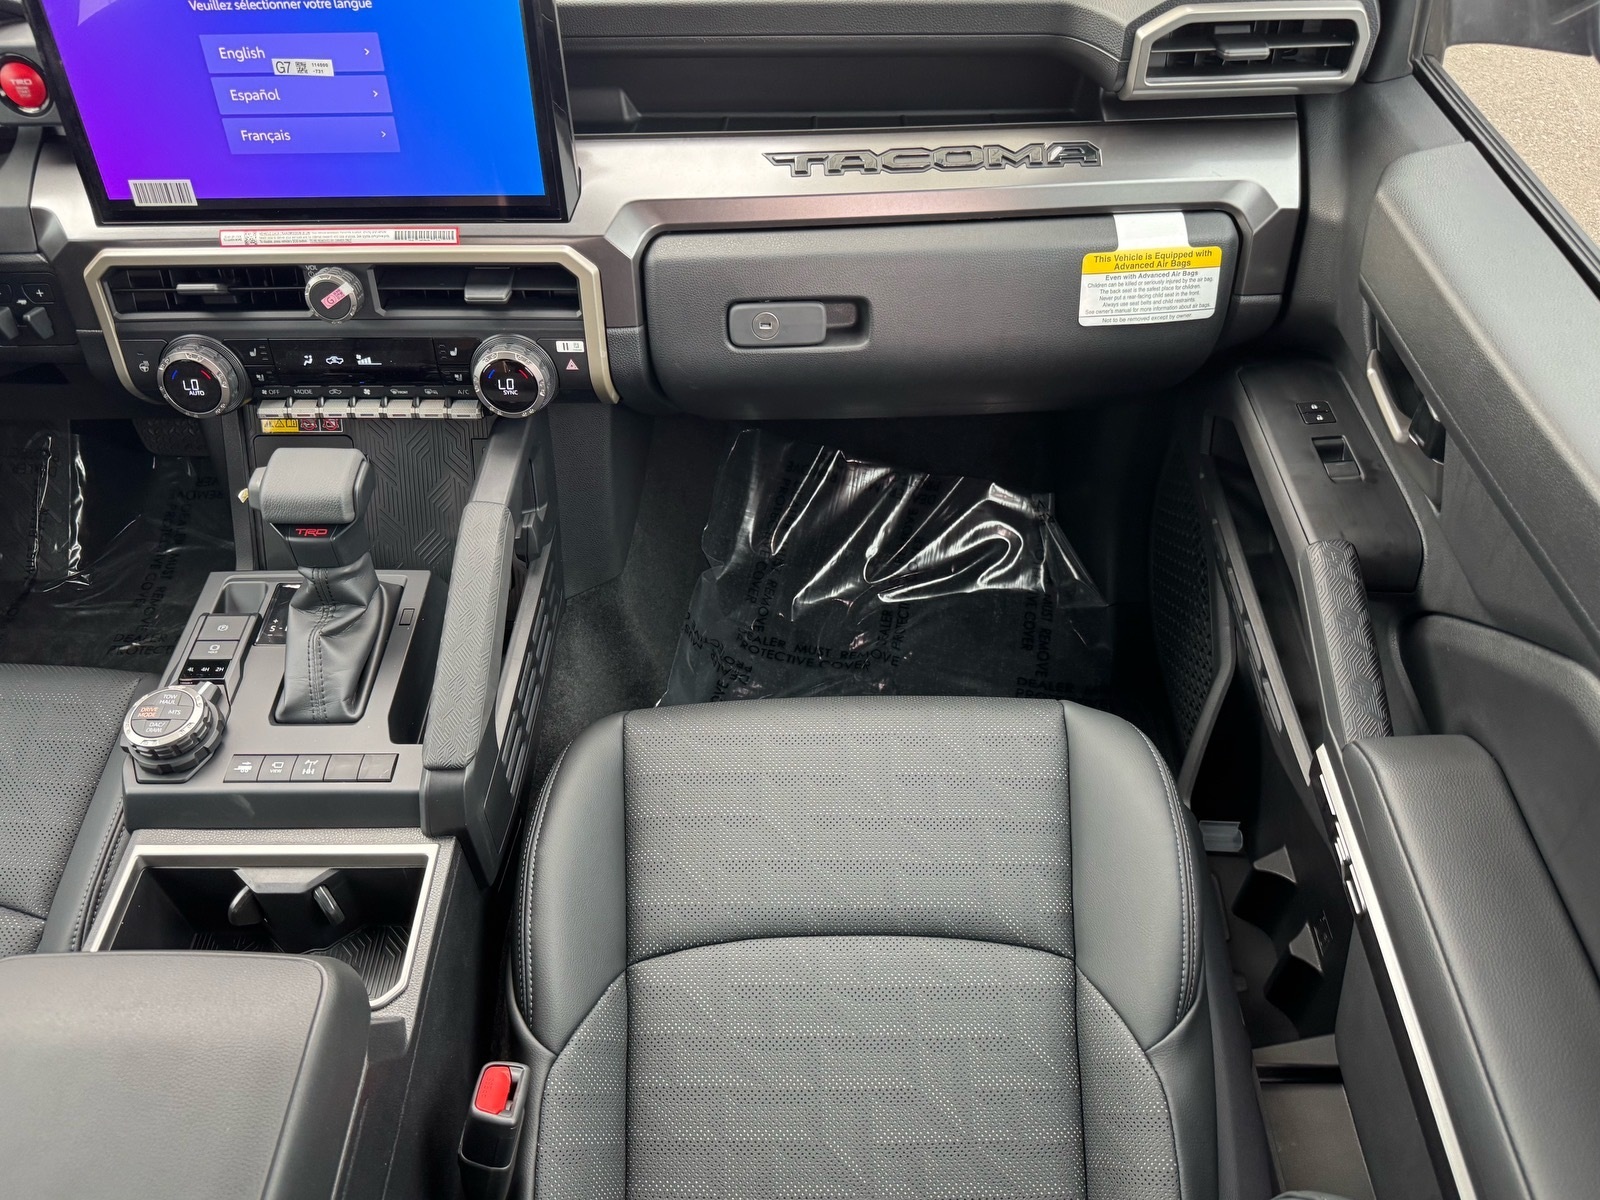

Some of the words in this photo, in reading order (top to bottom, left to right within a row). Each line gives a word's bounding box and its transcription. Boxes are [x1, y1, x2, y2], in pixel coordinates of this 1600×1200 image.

[188, 0, 233, 11] Veuillez
[304, 0, 332, 9] votre
[334, 0, 373, 11] langue
[218, 46, 266, 62] English
[275, 61, 291, 73] G7
[229, 88, 281, 103] Español
[240, 129, 291, 144] Français
[762, 141, 1103, 177] TACOMA
[1094, 255, 1112, 263] This
[1114, 253, 1144, 262] Vehicle
[1155, 251, 1194, 260] Equipped
[1195, 249, 1213, 257] with
[1114, 261, 1155, 271] Advanced
[1156, 260, 1169, 268] Air
[1170, 260, 1192, 269] Bags
[296, 528, 328, 537] TRD
[746, 561, 768, 604] COVER
[1020, 612, 1037, 651] COVER
[735, 632, 815, 668] PROTECTIVE
[819, 659, 872, 672] COVER
[794, 643, 832, 659] MUST
[839, 648, 900, 667] REMOVE
[1035, 628, 1051, 678] REMOVE
